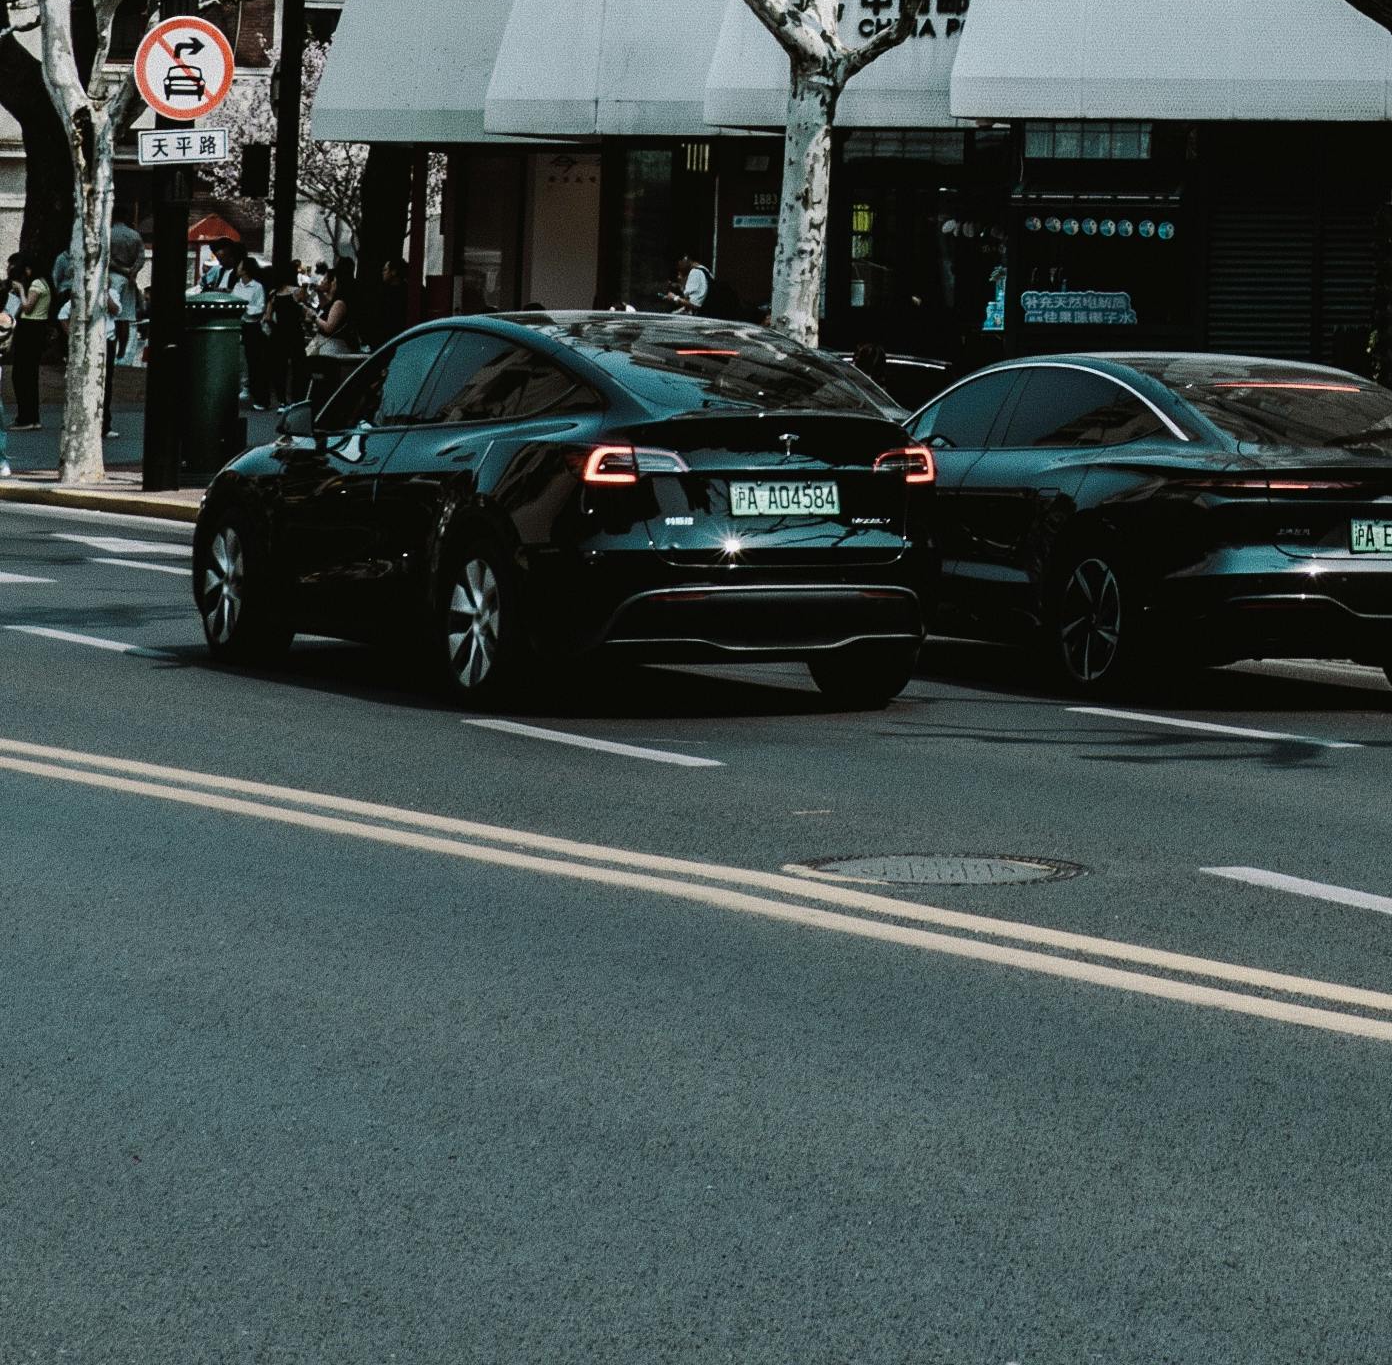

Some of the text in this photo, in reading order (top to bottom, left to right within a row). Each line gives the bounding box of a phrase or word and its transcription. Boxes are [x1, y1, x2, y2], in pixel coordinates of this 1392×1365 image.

[858, 18, 966, 38] CHA P
[151, 135, 217, 158] 天平路
[735, 485, 837, 510] 沪A A04584
[1355, 523, 1376, 547] 沪A
